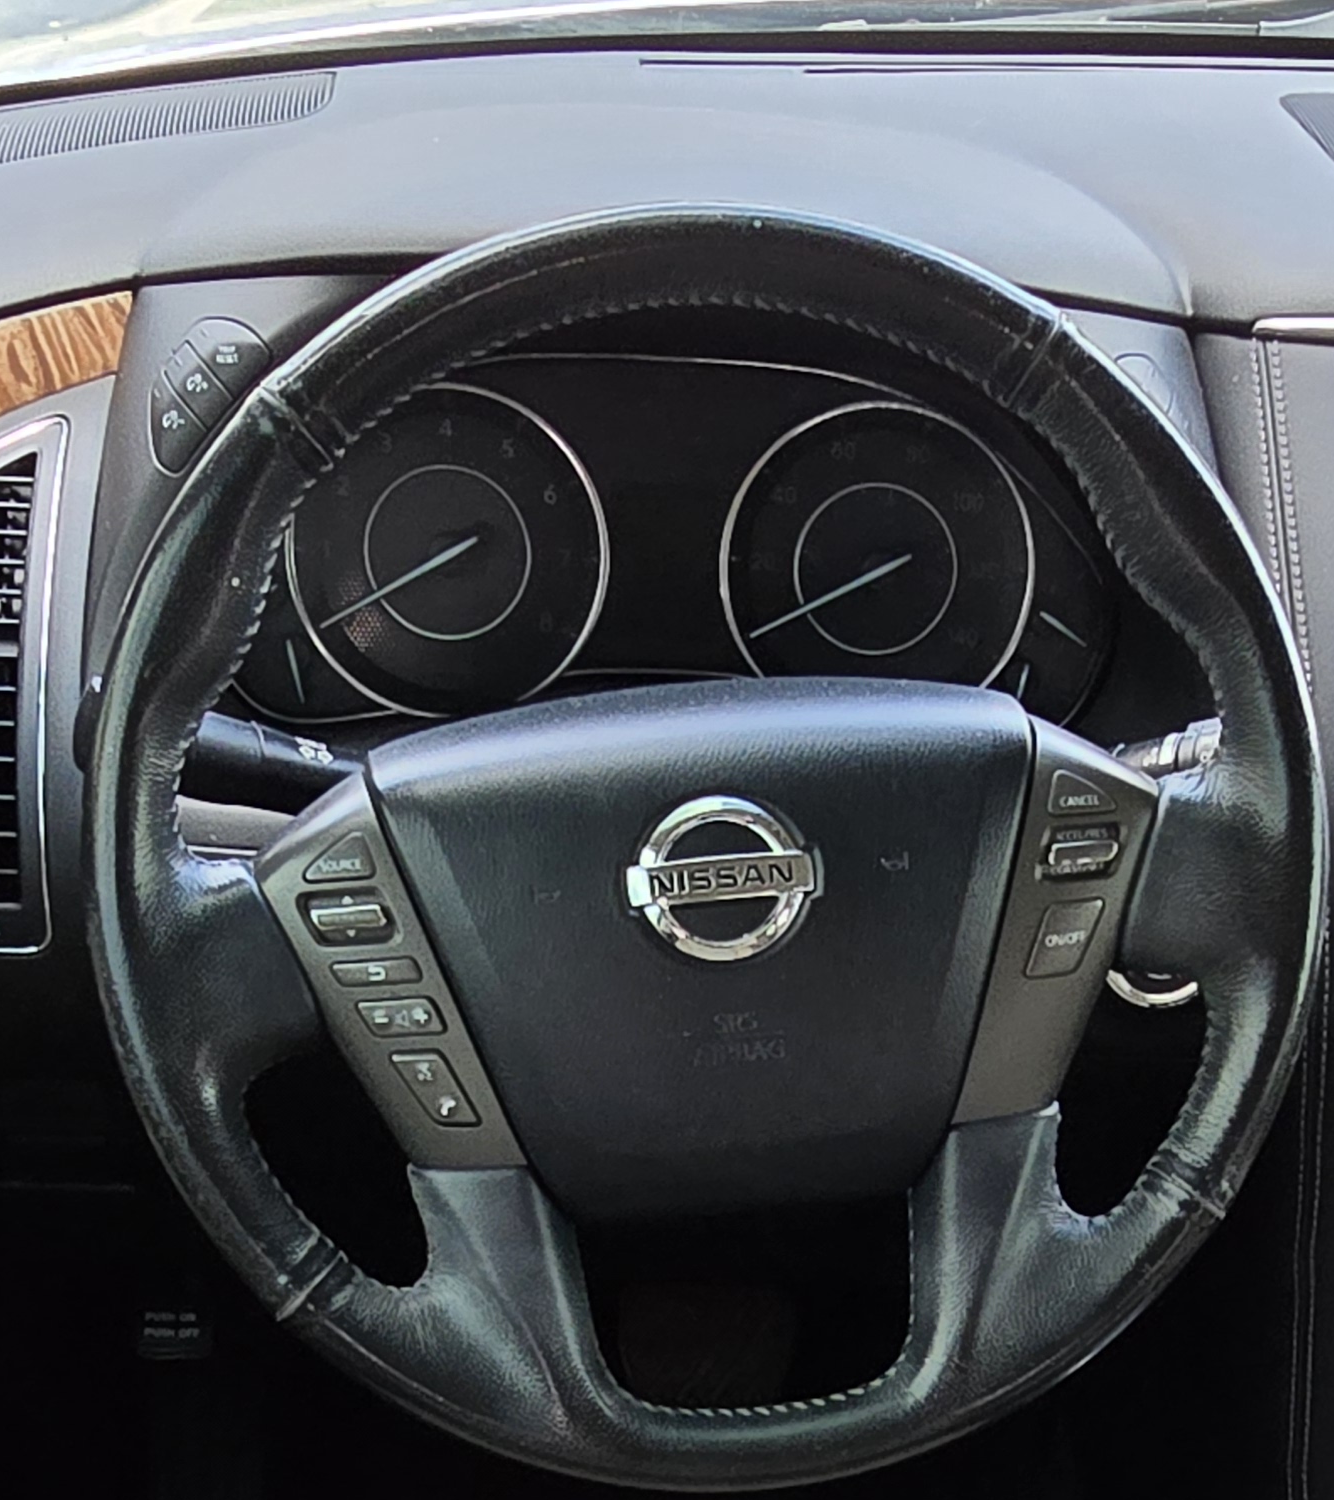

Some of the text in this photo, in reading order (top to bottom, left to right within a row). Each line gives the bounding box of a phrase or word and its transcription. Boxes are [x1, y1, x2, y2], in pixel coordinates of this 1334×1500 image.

[543, 485, 558, 506] 6
[1059, 793, 1101, 807] CANCEL
[650, 860, 794, 896] NISSAN
[1045, 930, 1086, 948] ON/OFF
